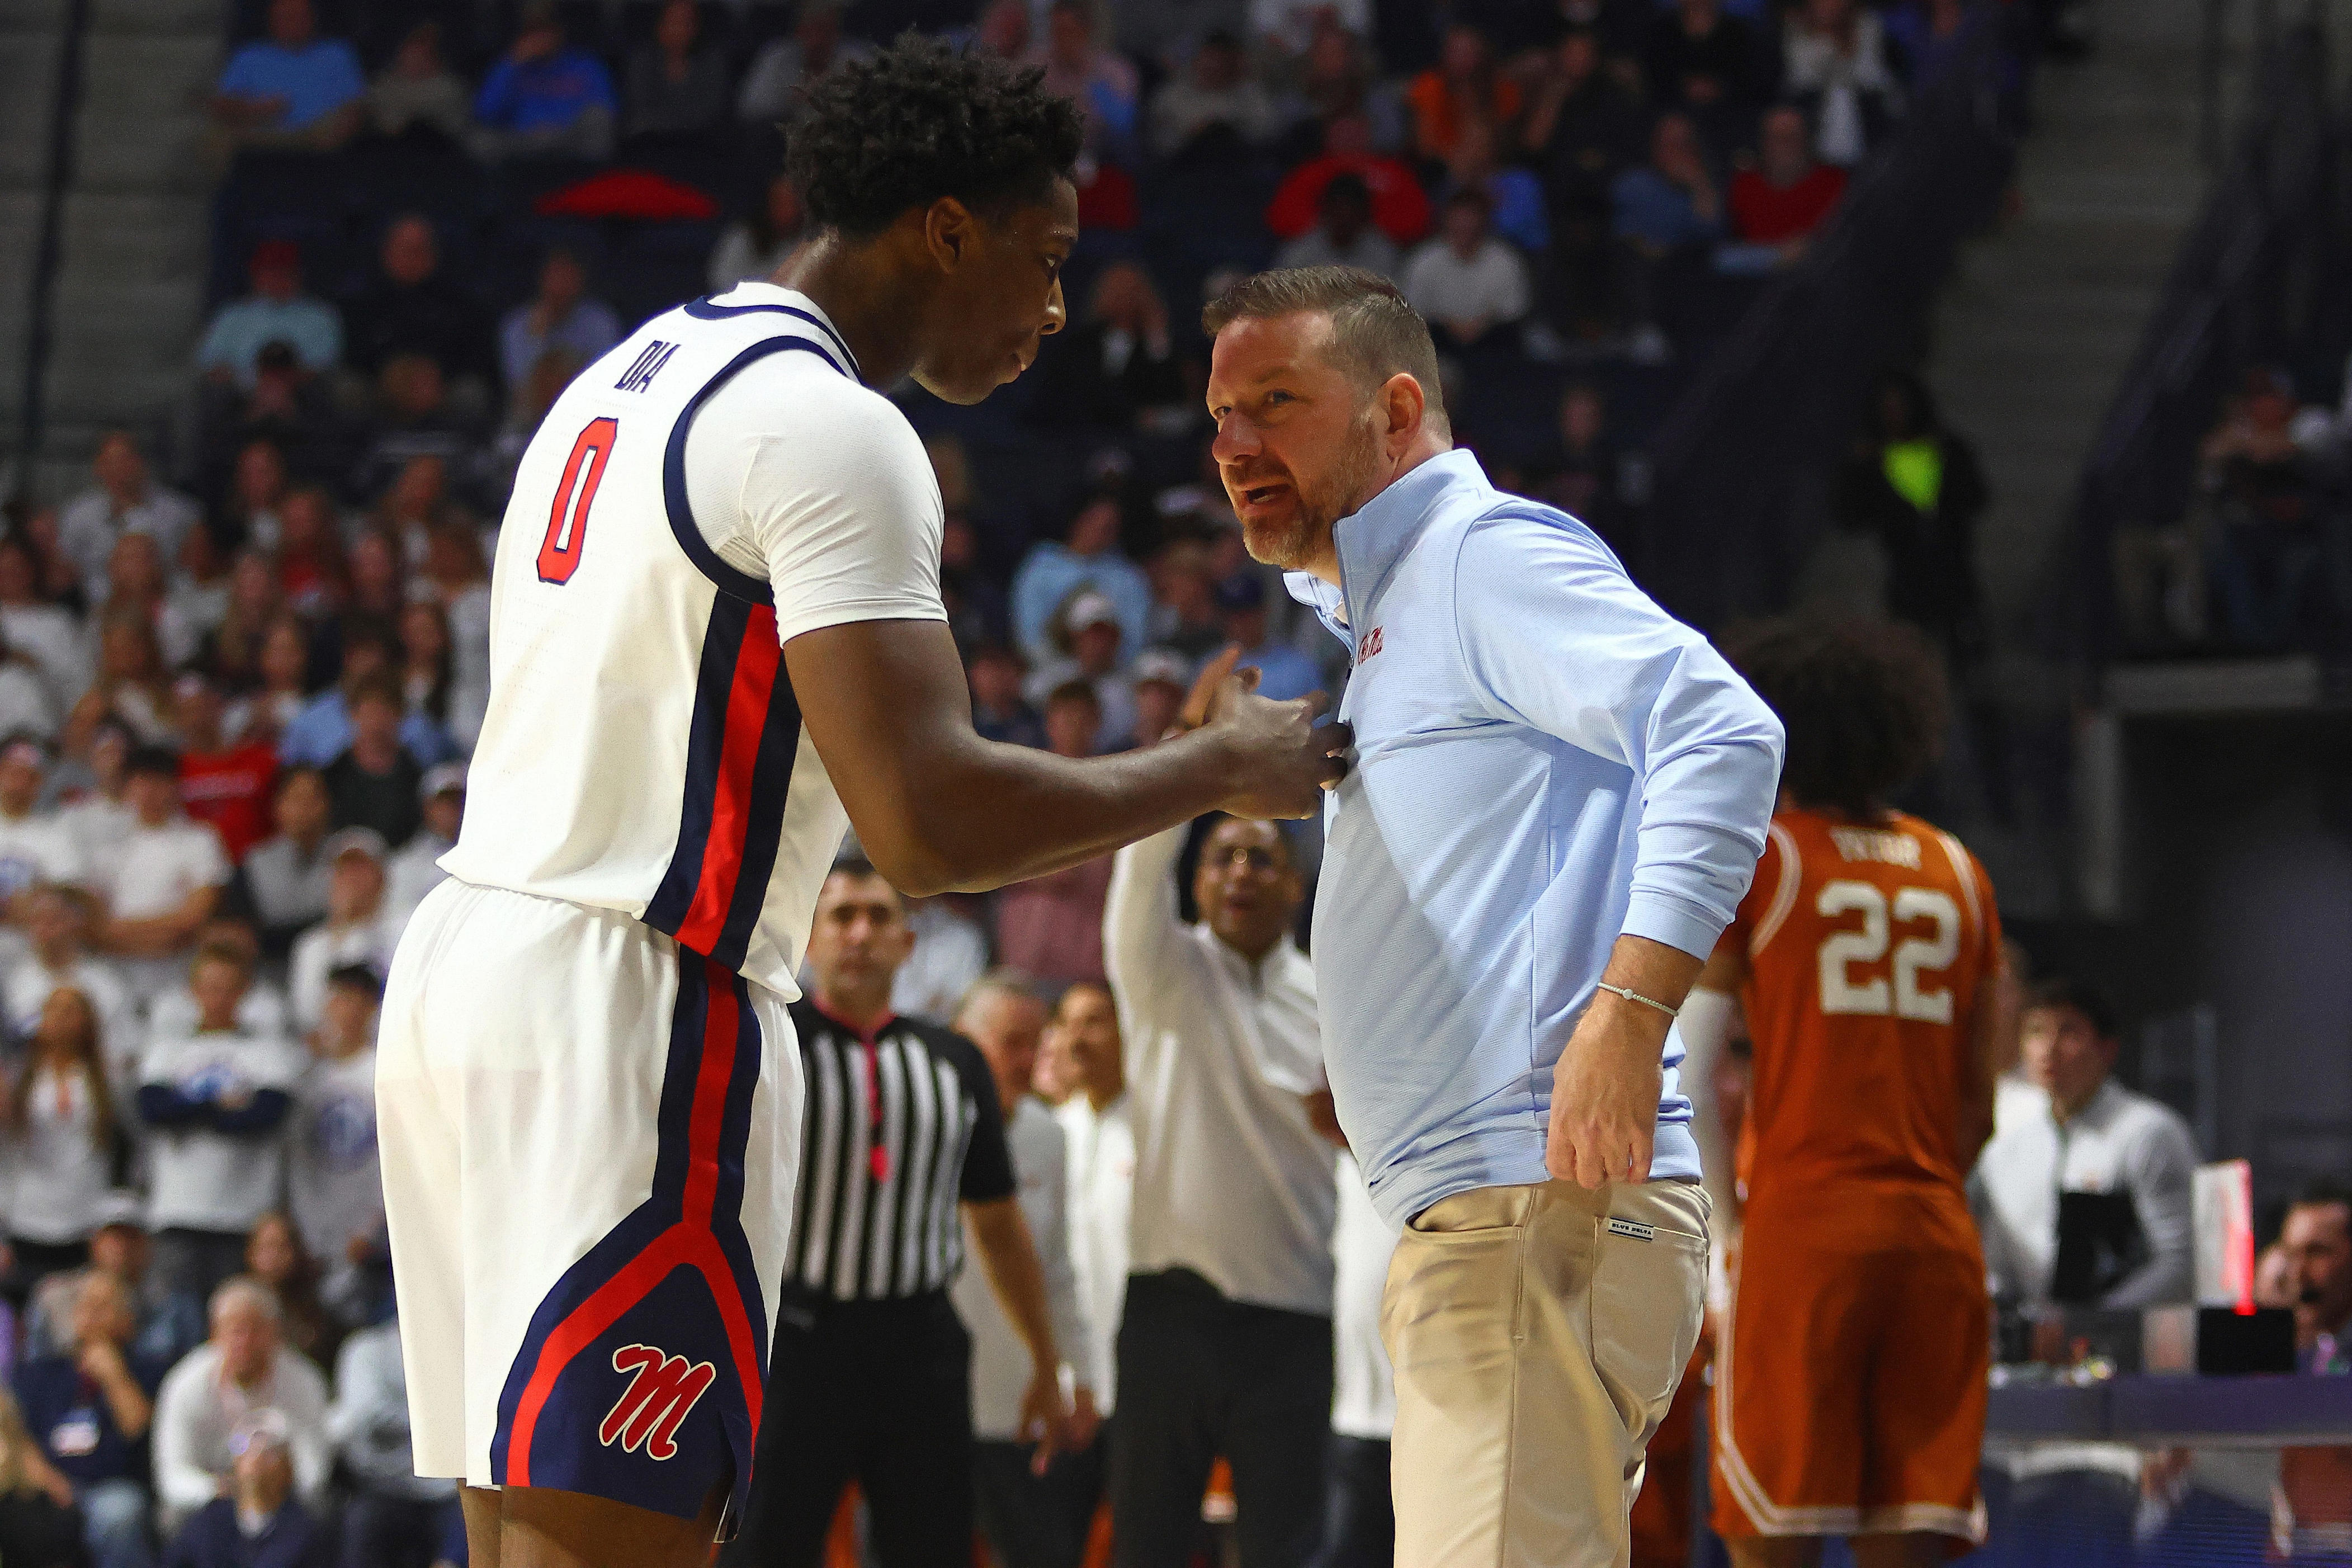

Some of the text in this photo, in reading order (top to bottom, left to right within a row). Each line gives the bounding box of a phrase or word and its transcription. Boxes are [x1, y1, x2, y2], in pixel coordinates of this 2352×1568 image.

[614, 340, 681, 393] DIA
[536, 416, 618, 586] 0
[1817, 879, 1959, 1025] 22
[1631, 1227, 1652, 1235] DELTA
